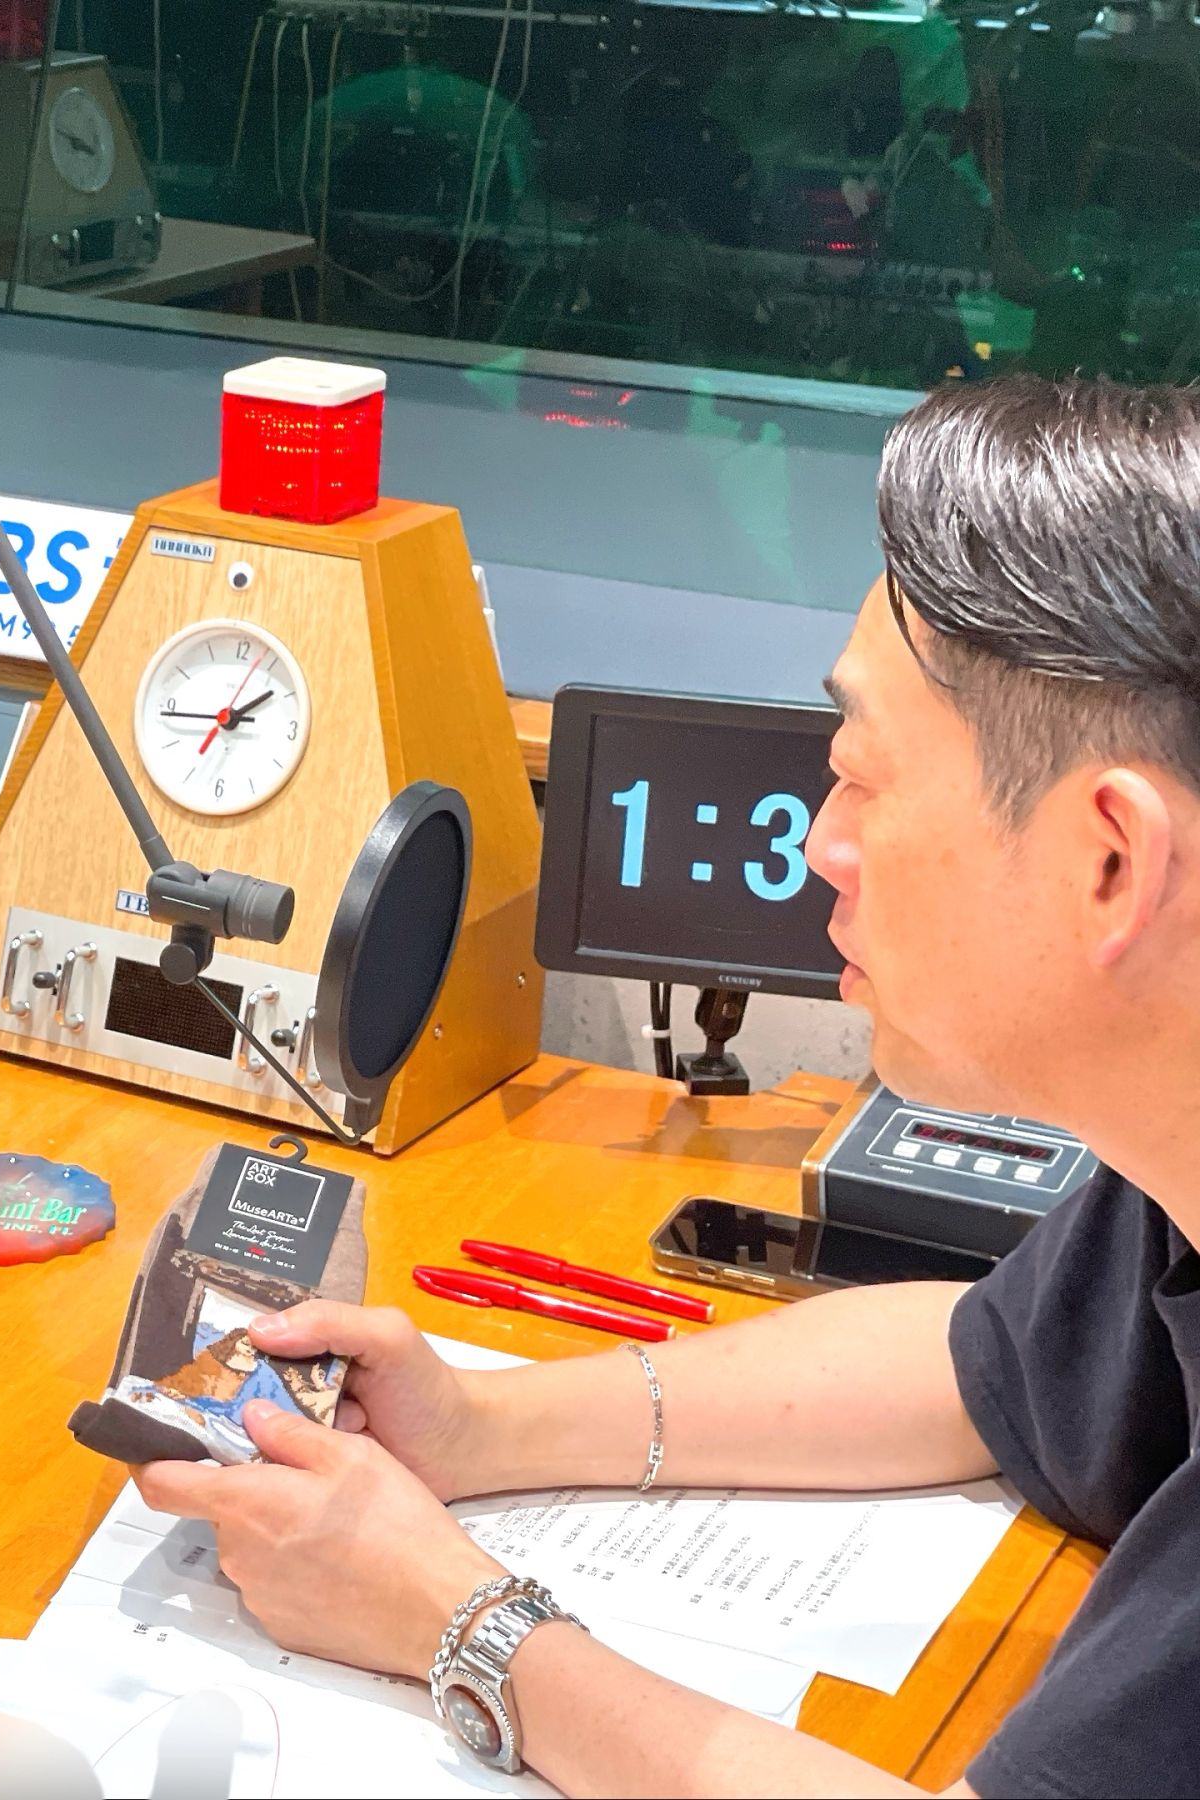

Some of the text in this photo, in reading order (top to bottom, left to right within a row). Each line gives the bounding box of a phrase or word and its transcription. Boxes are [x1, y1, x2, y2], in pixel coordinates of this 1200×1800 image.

[236, 640, 251, 661] 12
[287, 720, 298, 741] 3
[214, 778, 224, 798] 6
[246, 1170, 277, 1188] SOX
[248, 1162, 279, 1177] ART
[38, 1197, 88, 1225] Bar
